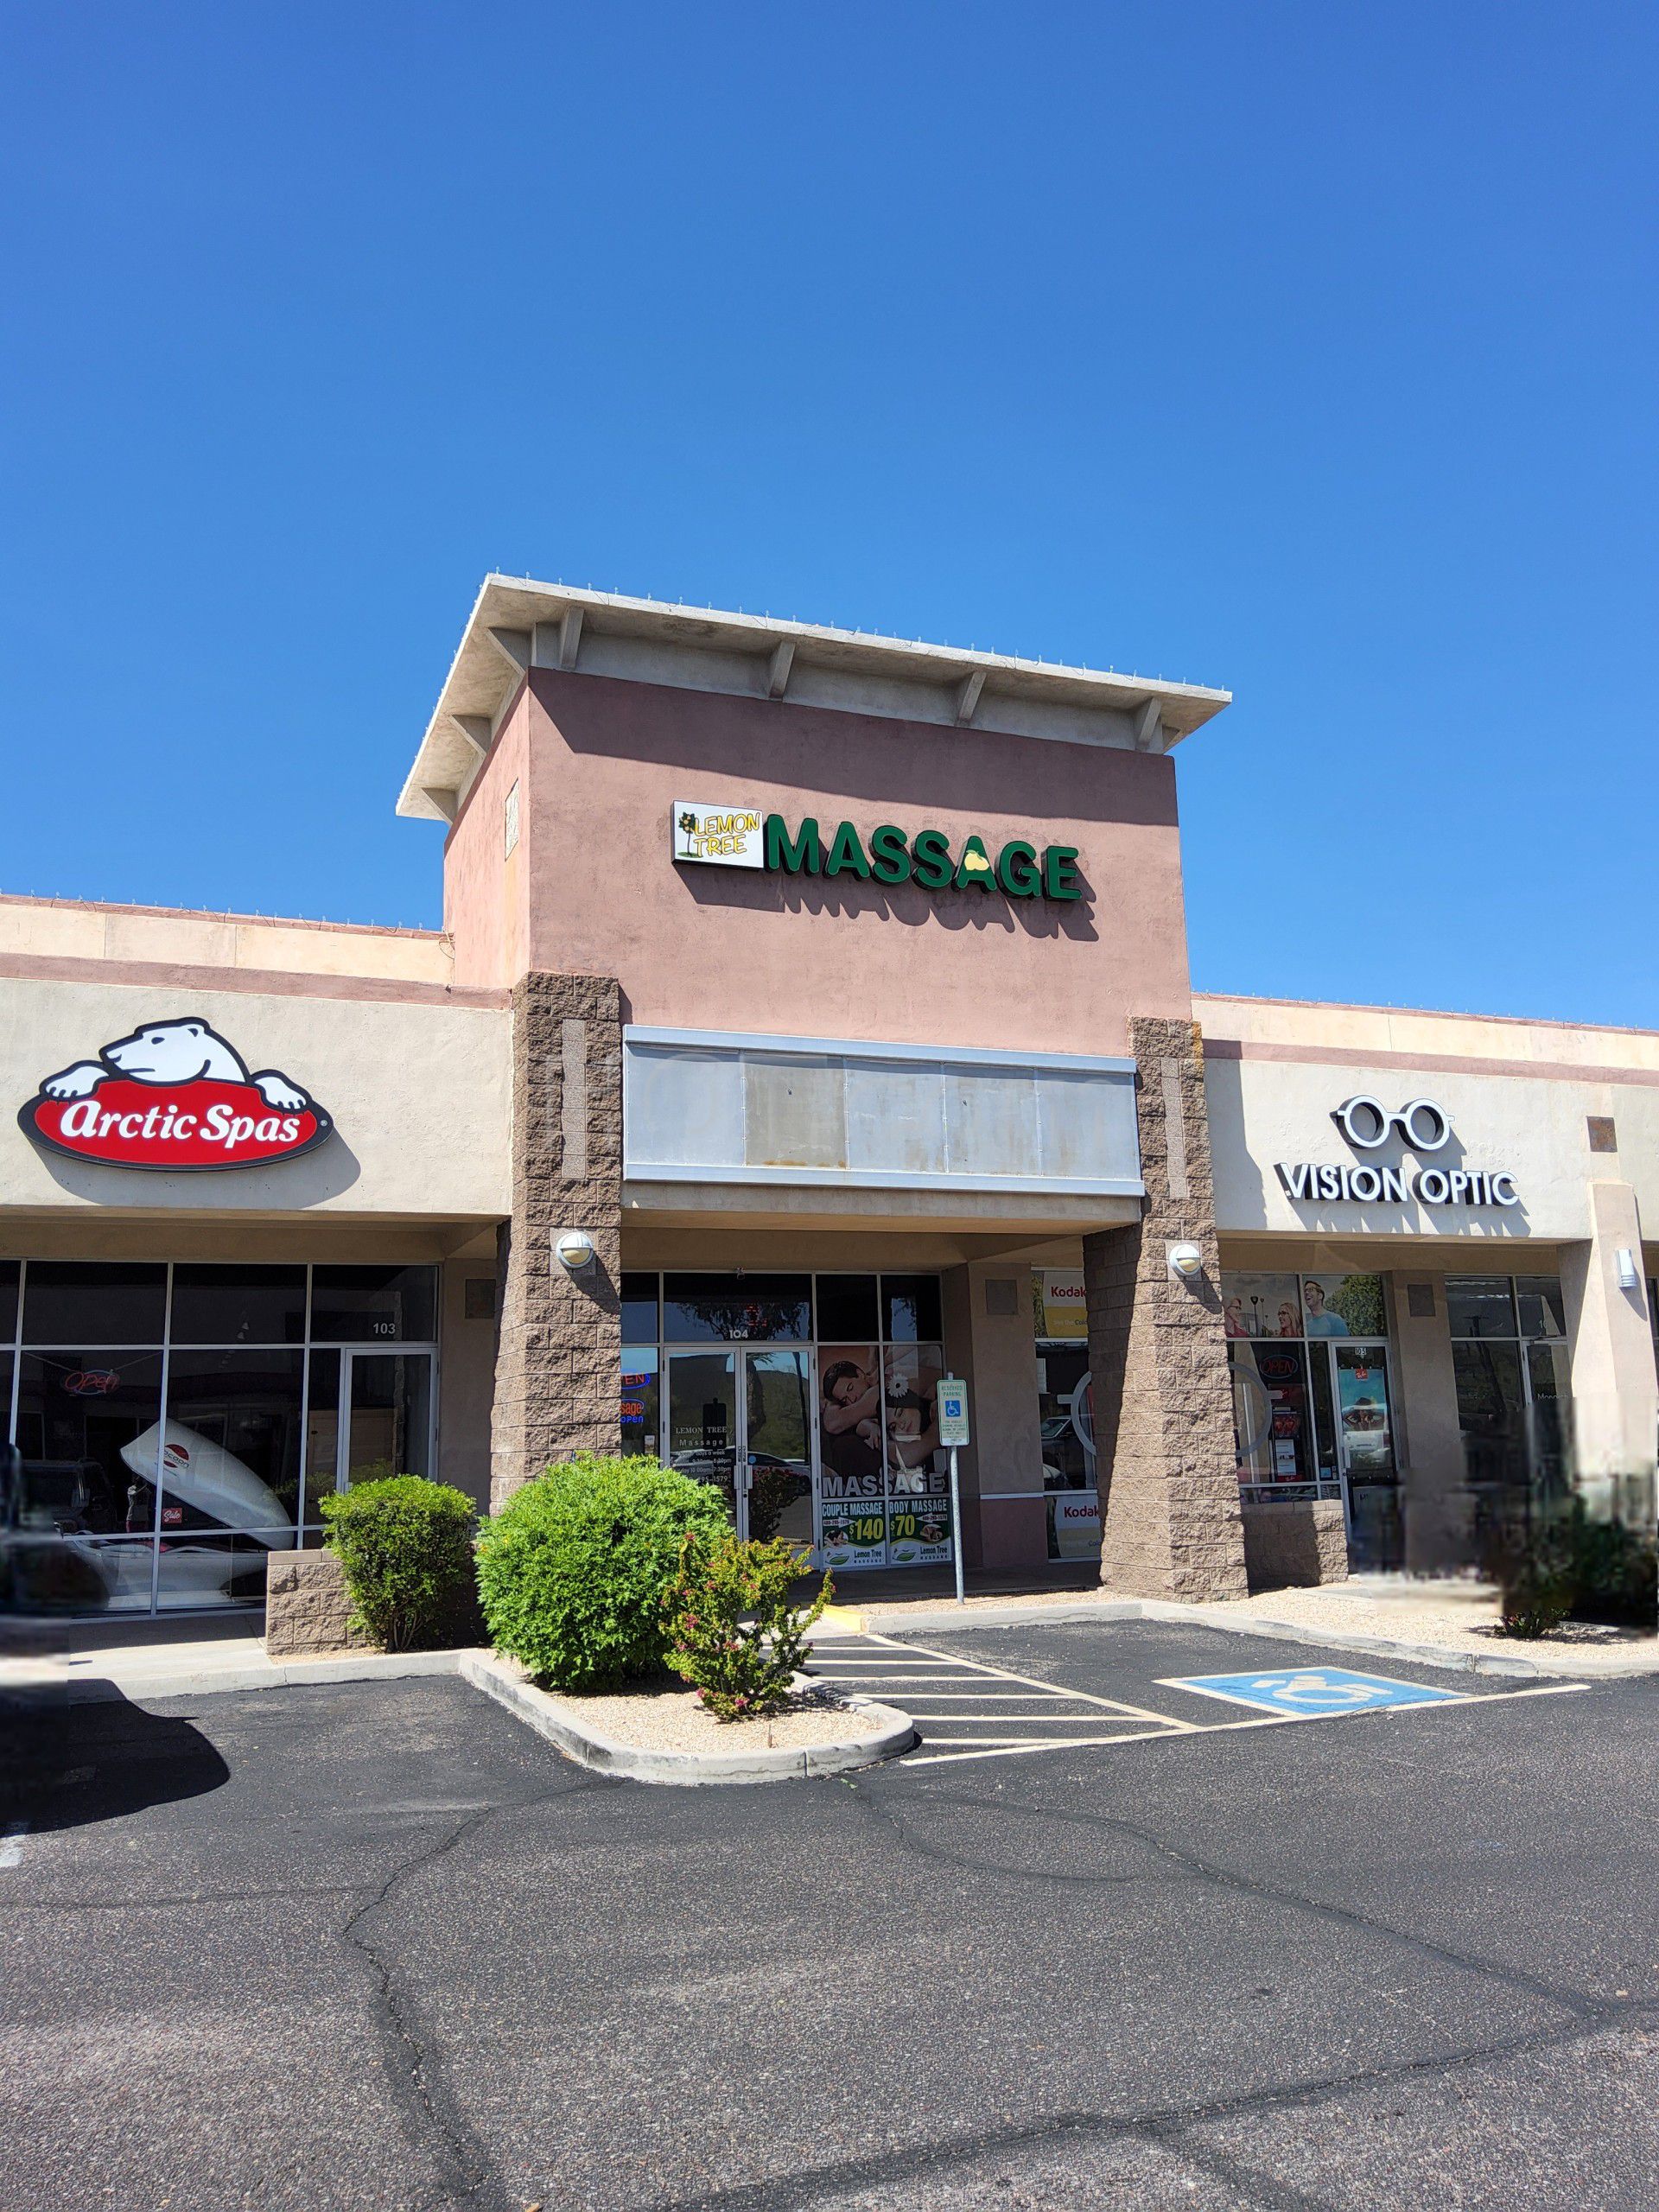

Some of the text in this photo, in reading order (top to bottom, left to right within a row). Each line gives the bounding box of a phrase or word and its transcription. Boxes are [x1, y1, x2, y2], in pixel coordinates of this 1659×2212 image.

[695, 812, 760, 836] LEMON
[693, 834, 747, 857] TREE
[766, 814, 1083, 900] MASSAGE
[60, 1100, 301, 1148] Arctic Spas
[1278, 1162, 1520, 1205] VISION OPTIC
[1051, 1286, 1086, 1297] Kodak
[373, 1322, 396, 1334] 103
[729, 1329, 749, 1338] 104
[1262, 1359, 1294, 1374] OPEN
[622, 1374, 645, 1384] EN
[621, 1402, 643, 1415] sage
[822, 1472, 945, 1497] MASSAGE
[822, 1502, 883, 1516] COUPLE MASSAGE
[889, 1499, 947, 1514] BODY MASSAGE
[1064, 1505, 1099, 1518] Kodak
[163, 1510, 181, 1522] Sale
[849, 1518, 884, 1541] $140
[890, 1515, 915, 1536] $70
[937, 1545, 947, 1554] Tree
